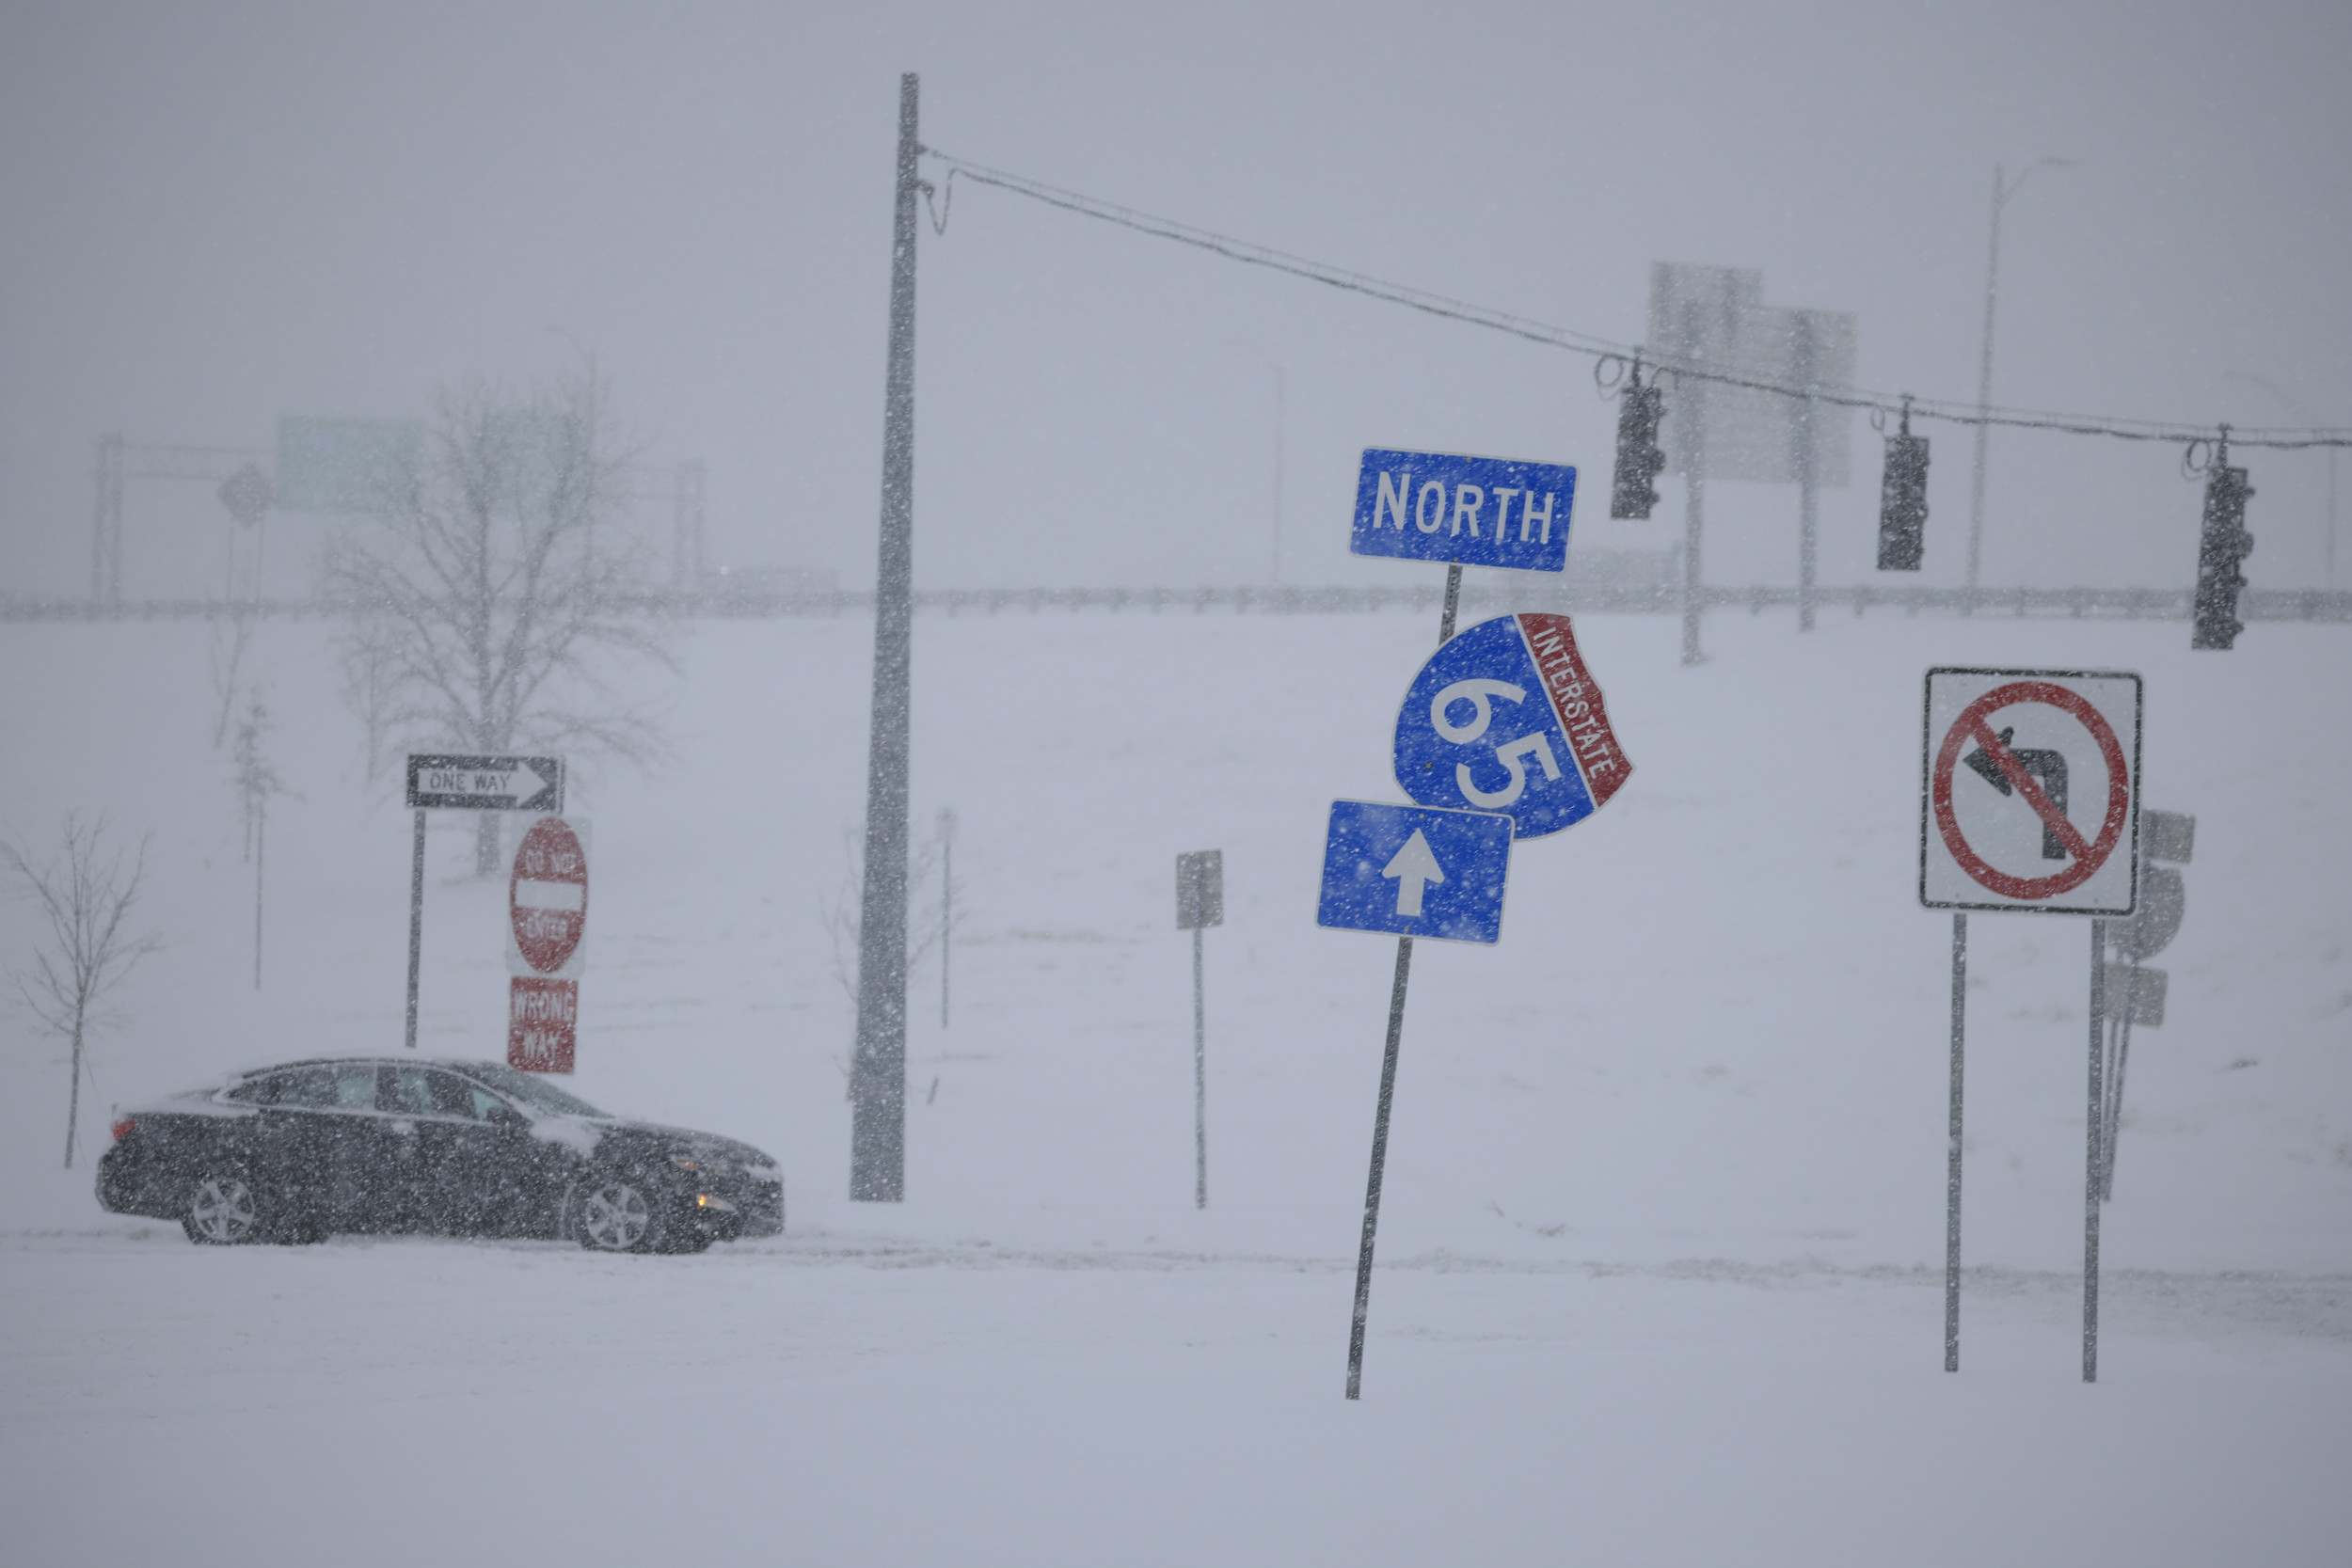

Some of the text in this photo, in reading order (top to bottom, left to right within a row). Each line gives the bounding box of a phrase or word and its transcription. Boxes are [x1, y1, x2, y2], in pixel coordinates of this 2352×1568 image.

[1373, 471, 1554, 544] NORTH
[1533, 627, 1615, 779] INTERSTATE
[1430, 678, 1562, 809] 65
[430, 771, 511, 792] ONE WAY
[525, 850, 543, 875] DO
[515, 991, 575, 1022] WRONG
[523, 1031, 559, 1060] WAY
